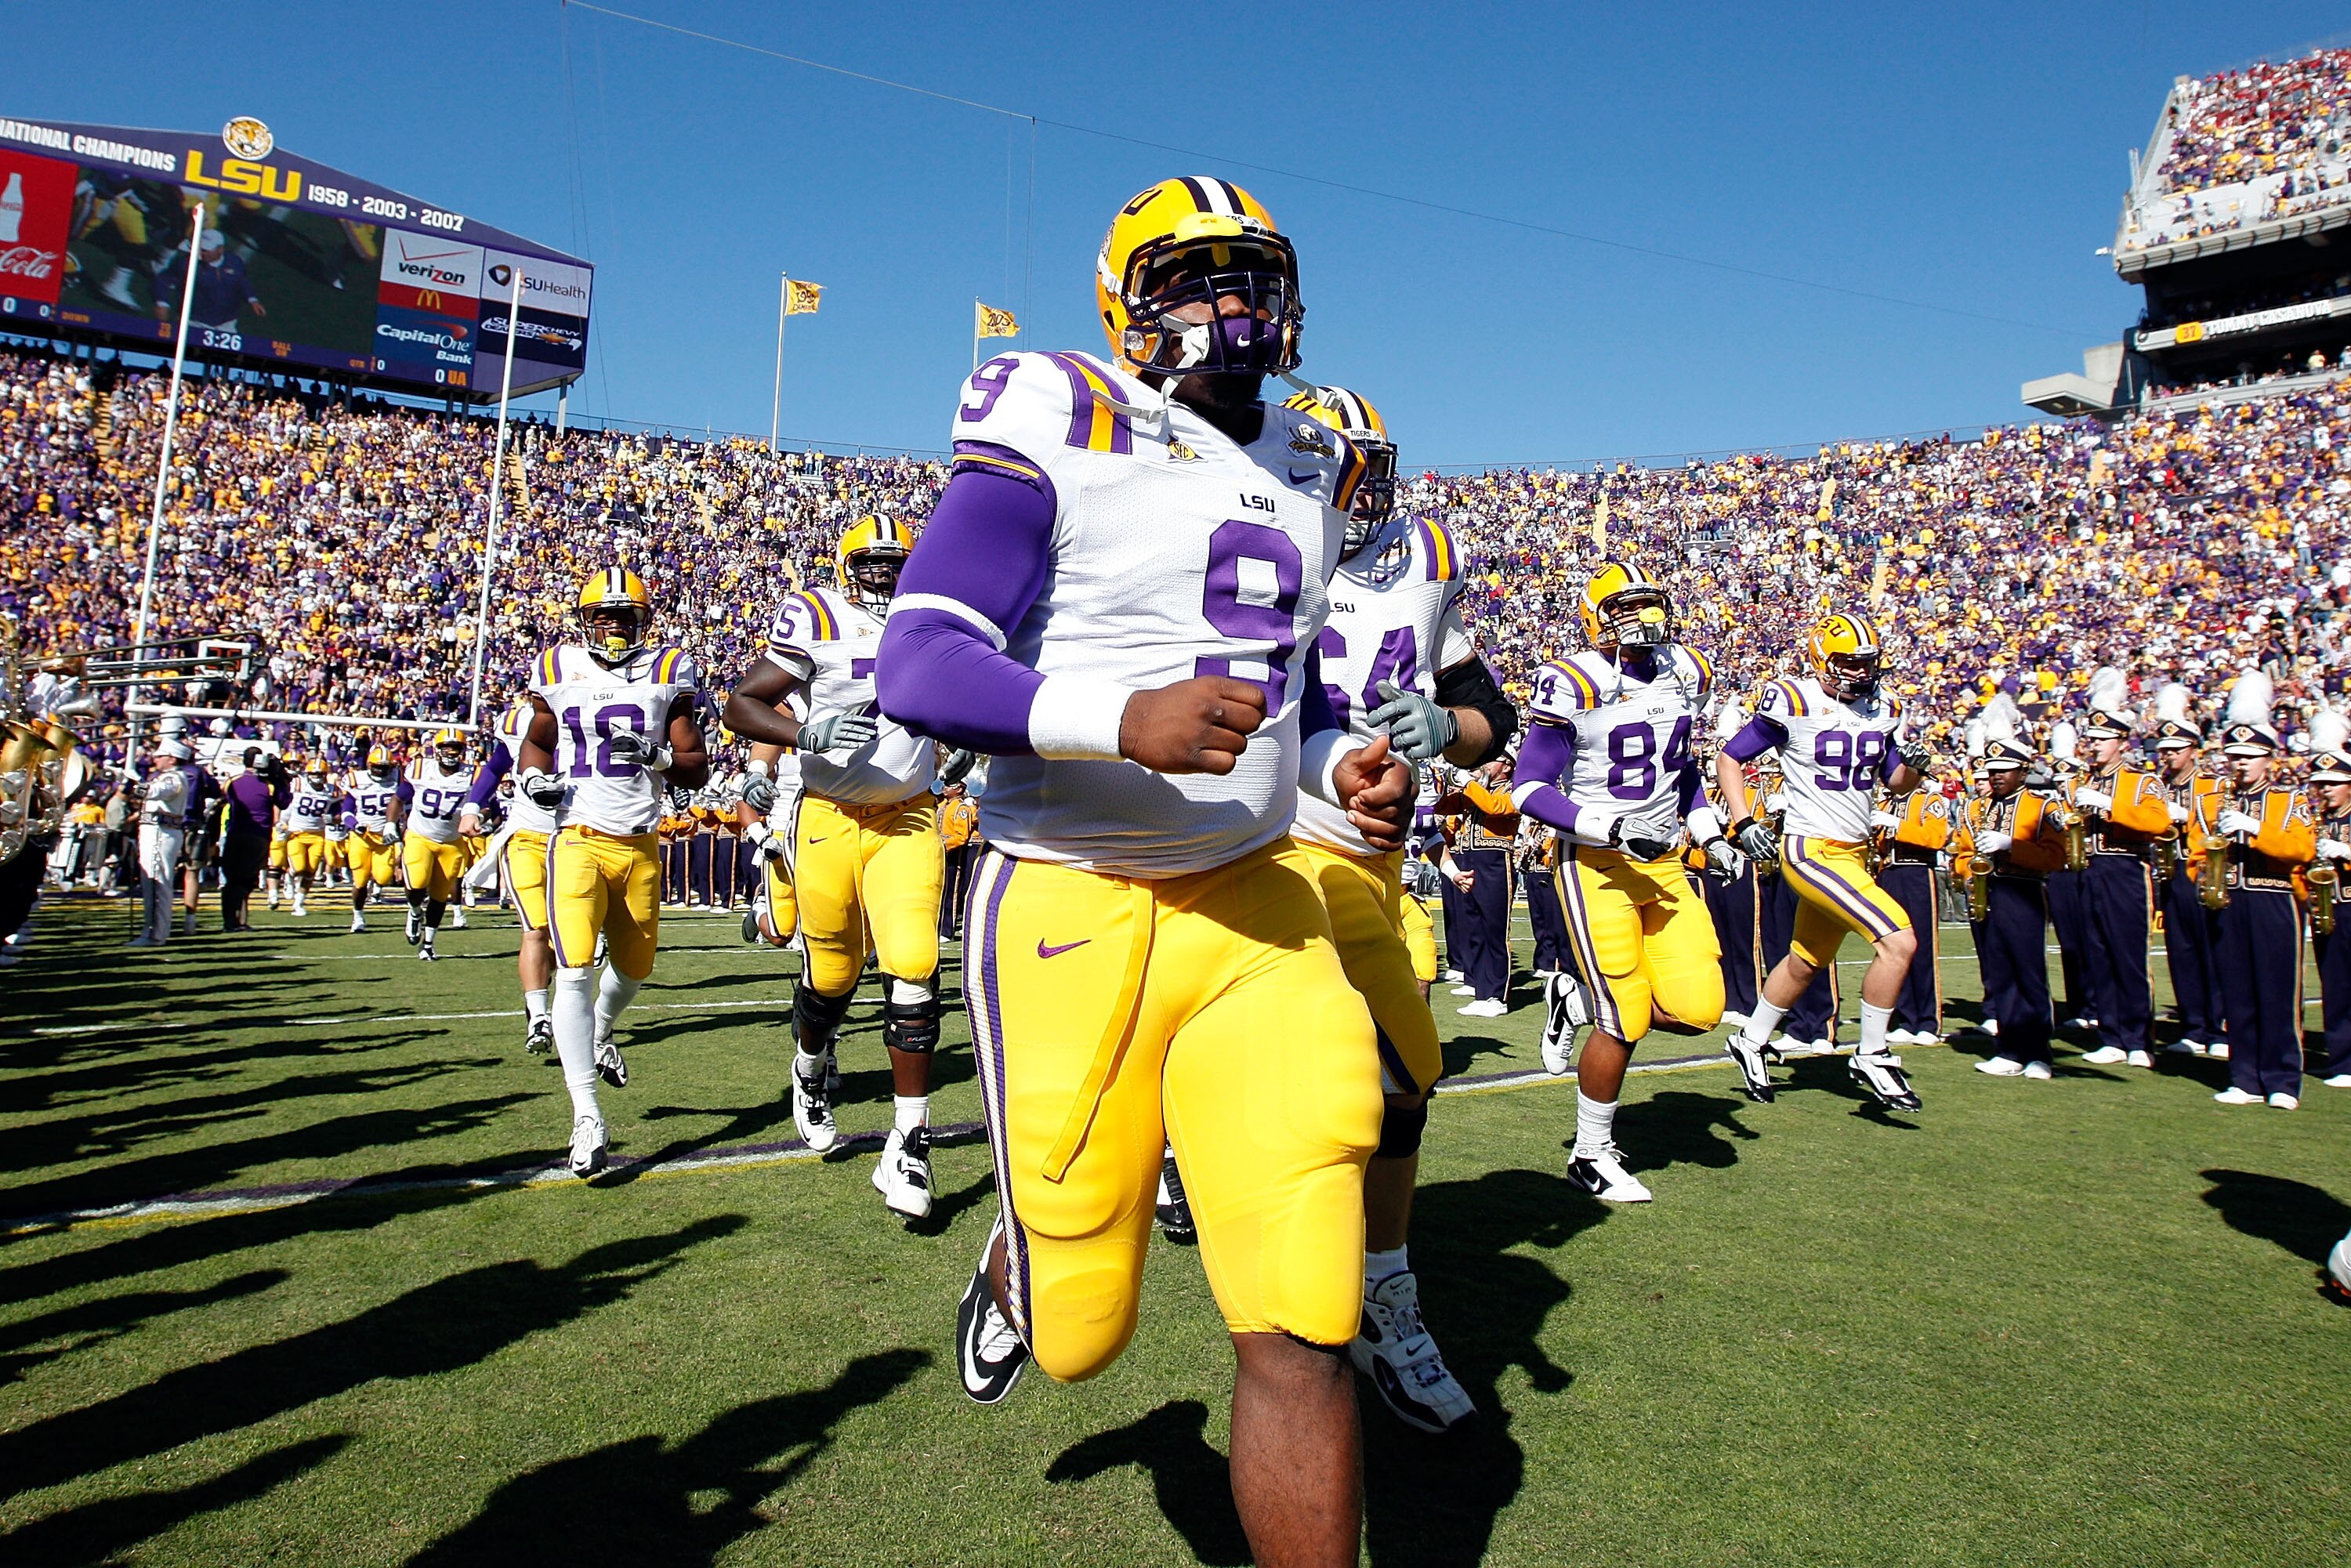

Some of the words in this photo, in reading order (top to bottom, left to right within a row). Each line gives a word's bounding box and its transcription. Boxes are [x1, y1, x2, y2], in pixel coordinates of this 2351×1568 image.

[72, 134, 176, 172] CHAMPIONS
[184, 150, 302, 202] LSU
[308, 183, 349, 208] 1958
[361, 196, 408, 220] 2003
[420, 208, 465, 233] 2007
[398, 261, 466, 285] verizon
[521, 276, 586, 300] SUHealth
[2, 297, 16, 313] 0
[39, 305, 51, 317] 0
[202, 329, 242, 351] 3:26
[2182, 326, 2197, 339] 37
[376, 359, 386, 371] 0
[436, 350, 472, 365] Bank
[434, 368, 445, 383] 0
[447, 369, 466, 386] UA
[960, 357, 1020, 422] 9
[1174, 442, 1190, 458] SEC
[1240, 493, 1276, 514] LSU
[1330, 602, 1356, 614] SU
[1194, 519, 1302, 719] 9
[593, 692, 614, 701] LSU
[1647, 707, 1665, 715] LSU
[1607, 715, 1692, 801] 84
[1814, 730, 1886, 791] 98
[298, 796, 328, 817] 88
[422, 788, 466, 820] 97
